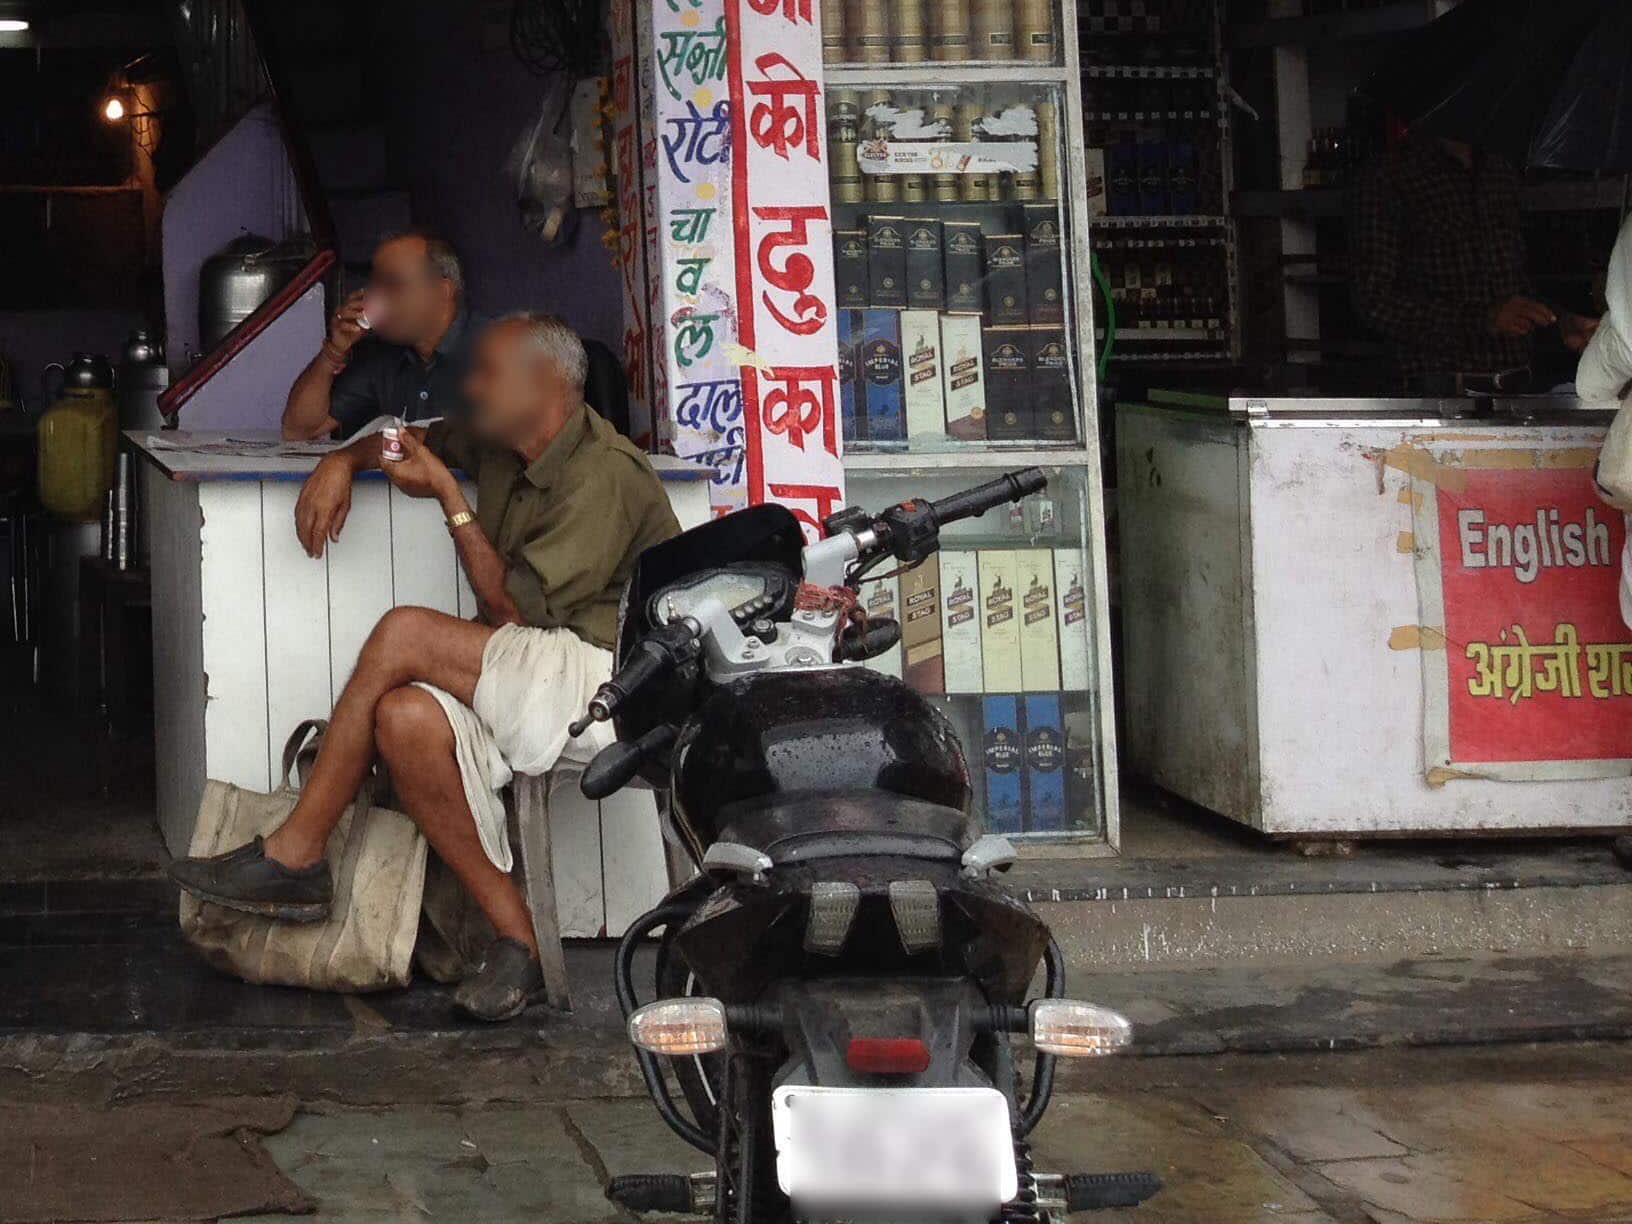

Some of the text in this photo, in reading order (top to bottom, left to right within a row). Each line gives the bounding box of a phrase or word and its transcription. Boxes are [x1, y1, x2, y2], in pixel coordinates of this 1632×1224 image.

[661, 100, 731, 184] रोटी
[675, 379, 743, 433] दाल
[1458, 508, 1612, 584] English
[1467, 624, 1582, 705] अंग्रेजी
